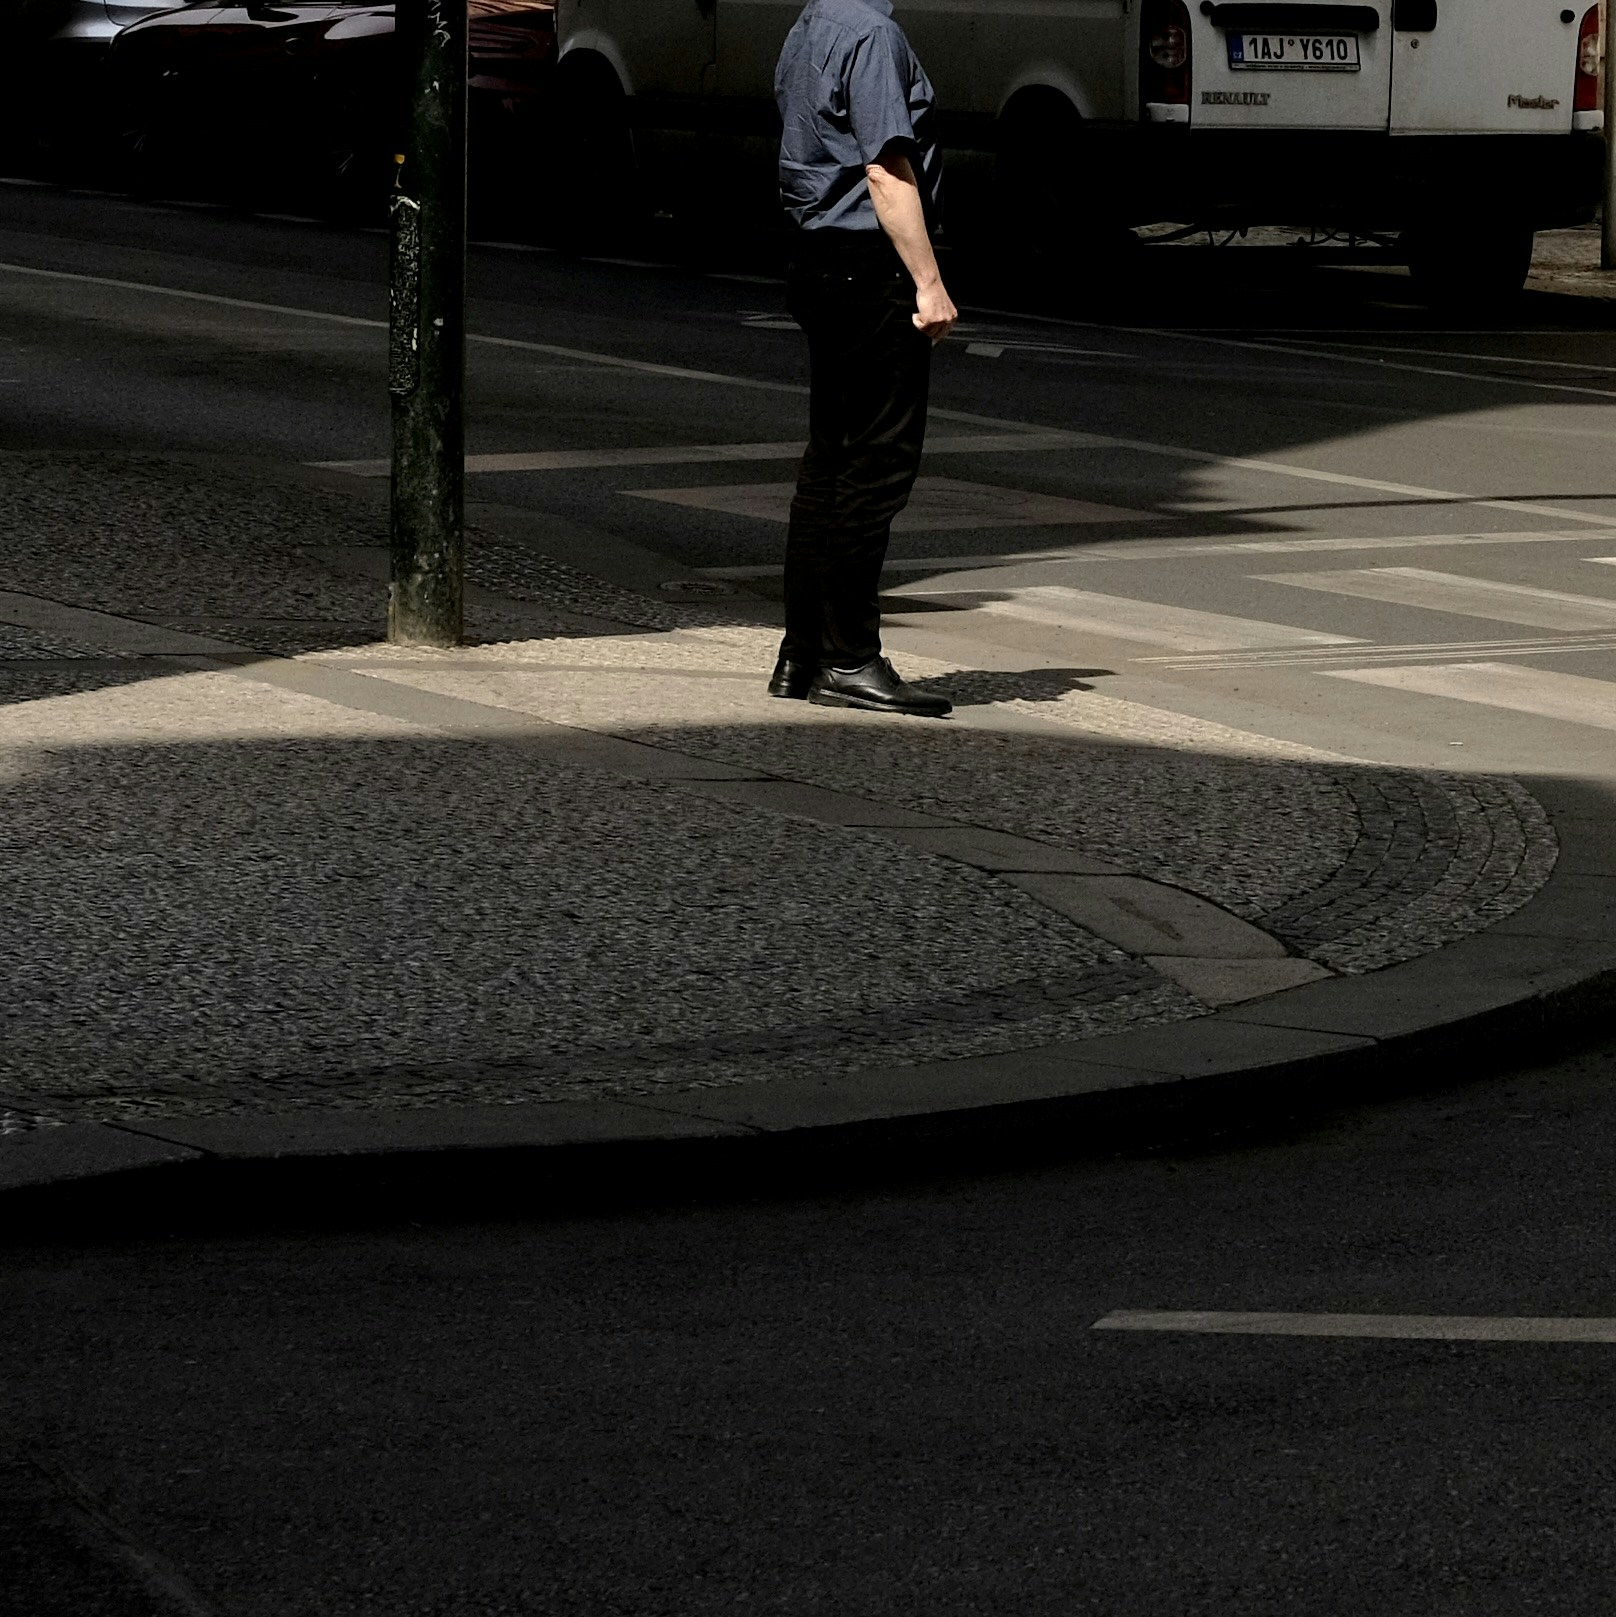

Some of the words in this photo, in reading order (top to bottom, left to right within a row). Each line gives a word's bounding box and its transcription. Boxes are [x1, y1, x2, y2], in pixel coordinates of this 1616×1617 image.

[1248, 37, 1284, 60] 1AJ
[1299, 38, 1348, 60] Y610
[1201, 91, 1270, 106] RENAULT
